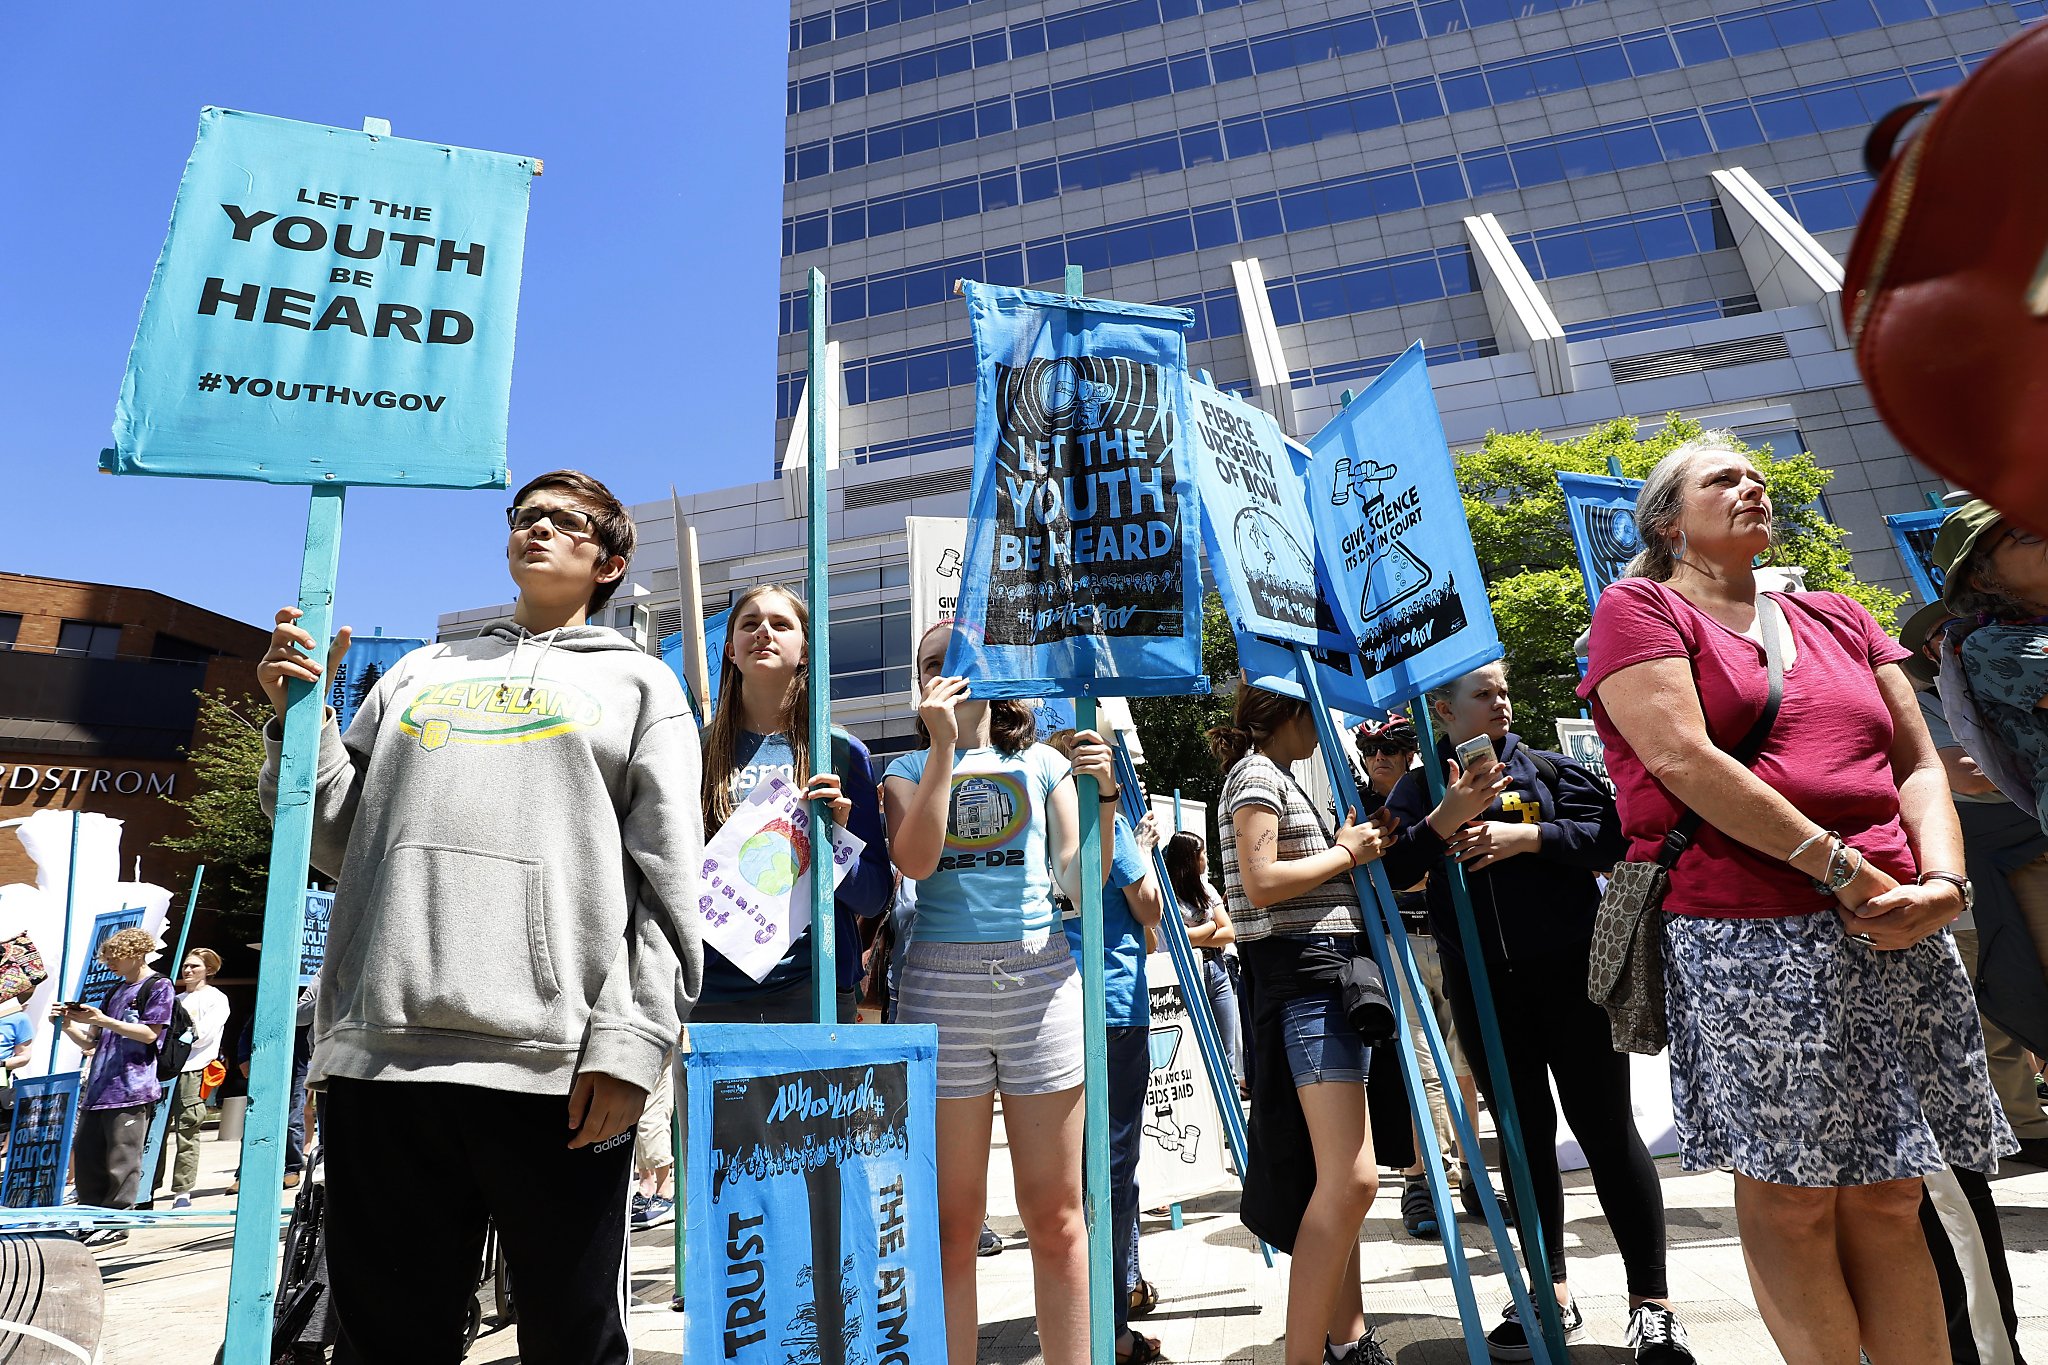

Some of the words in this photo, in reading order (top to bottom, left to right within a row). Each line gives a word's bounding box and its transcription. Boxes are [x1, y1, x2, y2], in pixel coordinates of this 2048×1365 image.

[297, 188, 359, 210] LET
[369, 199, 432, 222] THE
[220, 203, 486, 276] YOUTH
[329, 267, 374, 288] BE
[197, 277, 475, 345] HEARD
[198, 372, 447, 412] #YOUTHvGOV
[1200, 399, 1259, 447] FIERCE
[1018, 435, 1067, 471] LET
[1076, 430, 1148, 468] THE
[1197, 420, 1275, 479] URGENCY
[1005, 466, 1166, 529] YOUTH
[1215, 456, 1239, 487] OF
[1239, 466, 1281, 507] NOW
[1342, 523, 1366, 554] GIVE
[1369, 485, 1420, 536] SCIENCE
[1345, 554, 1357, 572] ITS
[1358, 538, 1375, 563] DAY
[1377, 531, 1388, 549] IN
[1390, 506, 1422, 539] COURT
[1000, 534, 1040, 572] BE
[1049, 520, 1173, 569] HEARD
[939, 597, 957, 608] GIV
[409, 683, 601, 727] CLEVELAND
[768, 777, 811, 836] Tim
[937, 849, 1025, 873] R2-D2
[698, 895, 730, 928] Out
[701, 858, 777, 945] Running
[303, 931, 328, 945] YOUT
[304, 920, 315, 929] LET
[317, 921, 329, 931] TH
[301, 946, 309, 955] BE
[311, 946, 325, 957] HEA
[1155, 1074, 1163, 1085] IN
[1165, 1071, 1180, 1085] DAY
[1173, 1083, 1194, 1101] GIVE
[1182, 1069, 1192, 1081] ITS
[12, 1144, 58, 1169] YOUTH
[593, 1131, 631, 1154] adidas
[879, 1174, 906, 1258] THE
[723, 1211, 767, 1359] TRUST
